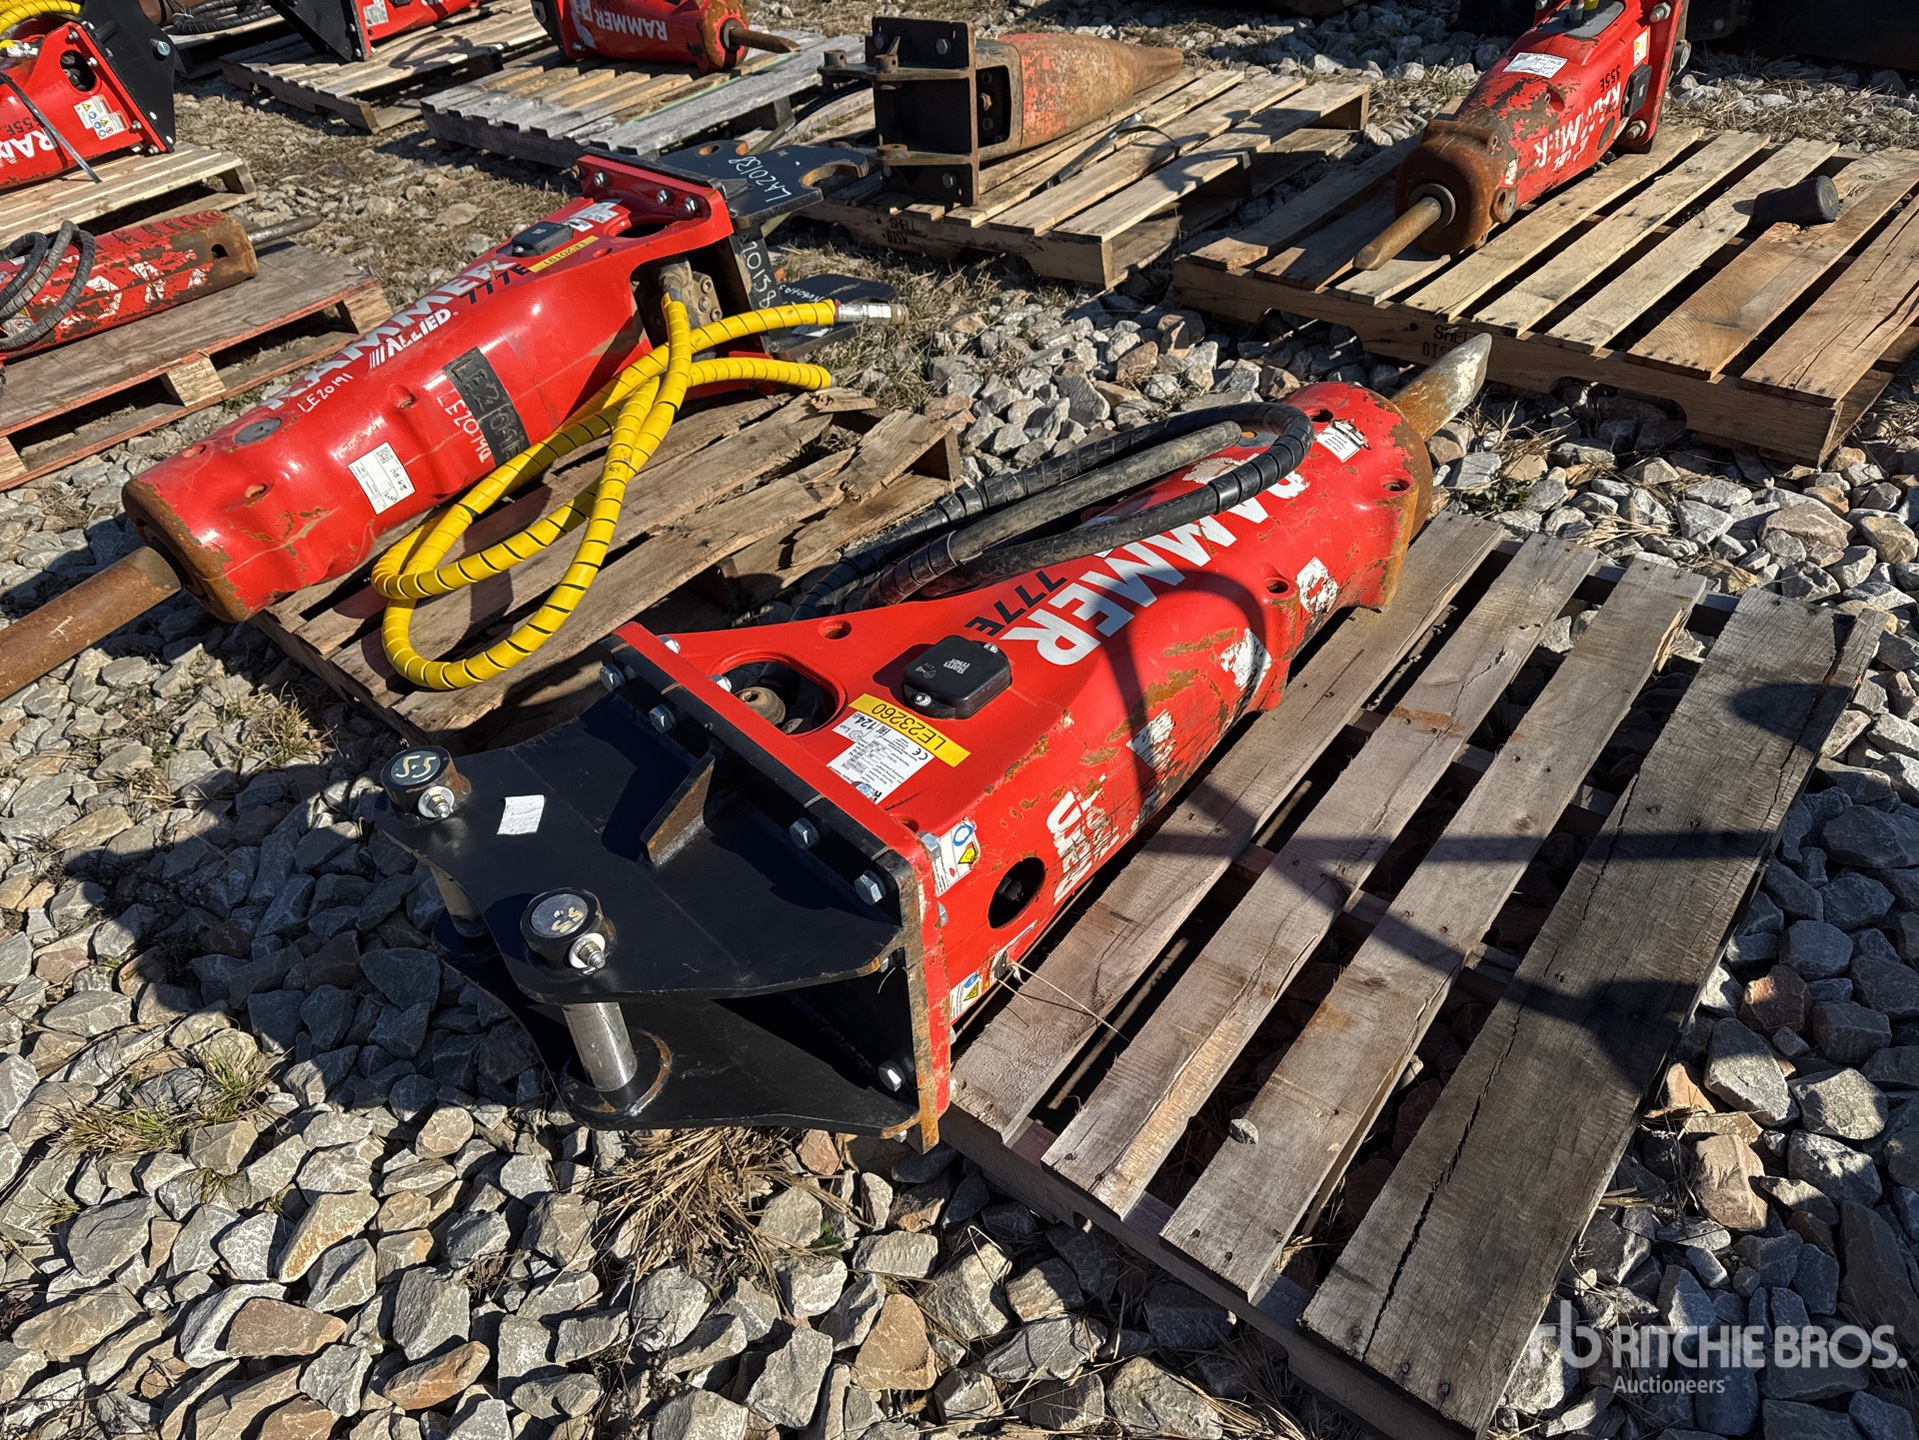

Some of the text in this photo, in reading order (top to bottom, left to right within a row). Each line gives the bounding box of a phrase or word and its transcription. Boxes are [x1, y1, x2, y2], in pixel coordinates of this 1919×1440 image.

[593, 9, 669, 41] RAMMER
[460, 264, 530, 305] 777E
[384, 308, 453, 358] ALLIED
[297, 372, 354, 413] LE20191
[964, 570, 1068, 637] 777E
[854, 715, 878, 731] 124
[871, 703, 947, 751] LE23260
